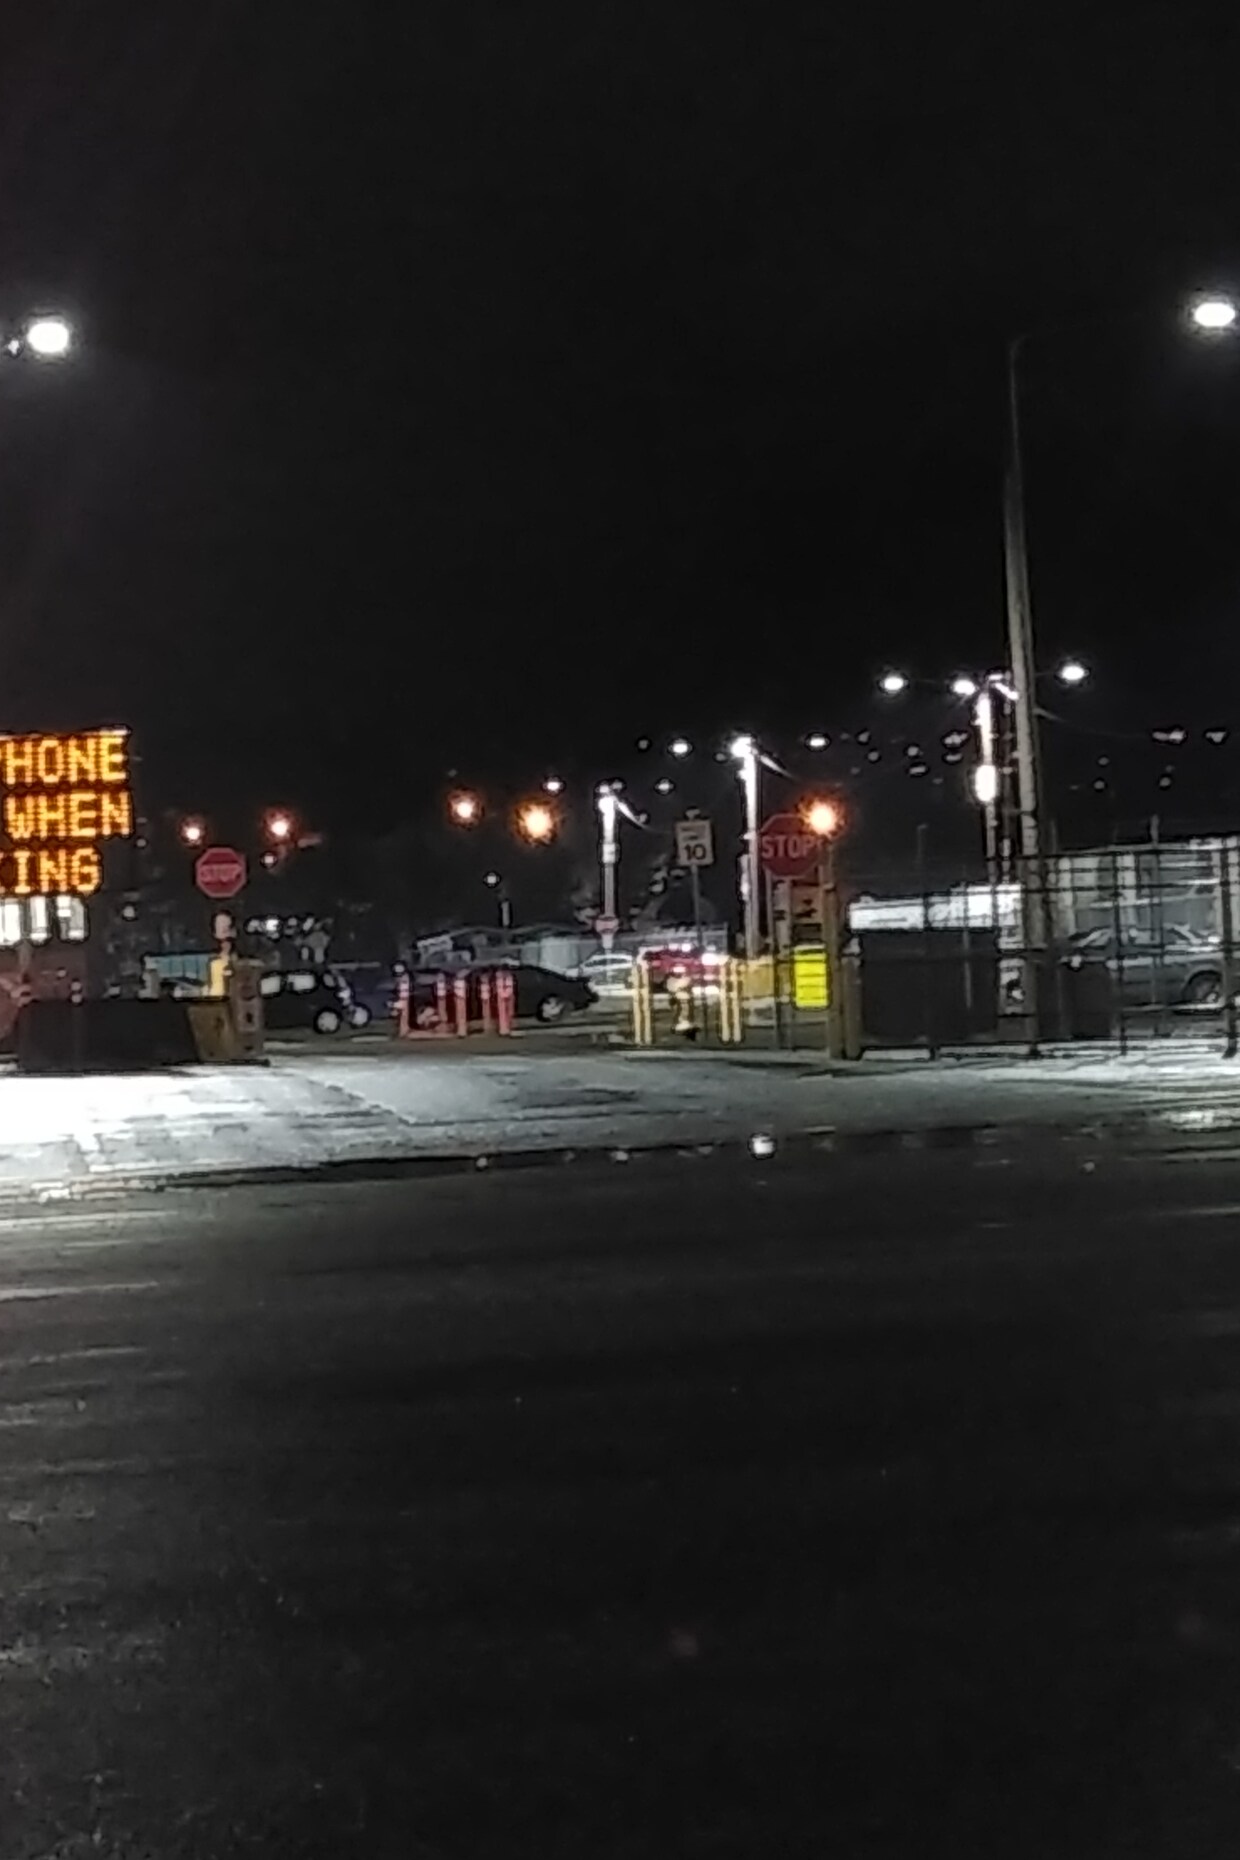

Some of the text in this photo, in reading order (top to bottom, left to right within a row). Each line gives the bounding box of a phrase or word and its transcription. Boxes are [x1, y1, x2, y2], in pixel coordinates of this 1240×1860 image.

[5, 791, 131, 839] WHEN
[684, 844, 707, 861] 10
[761, 835, 816, 858] STOP
